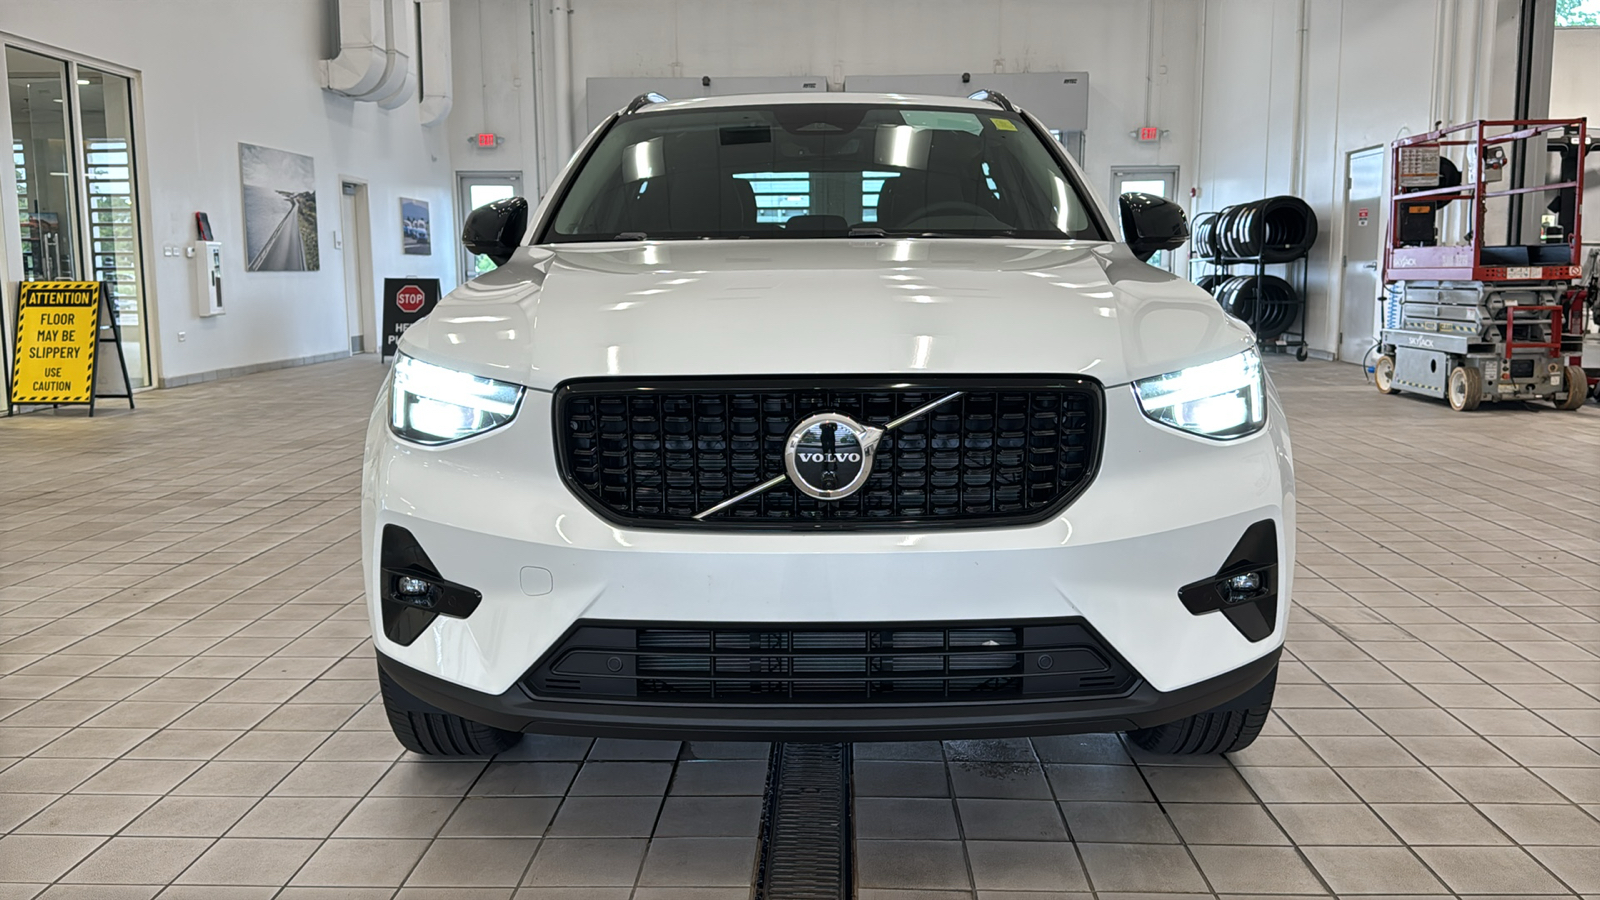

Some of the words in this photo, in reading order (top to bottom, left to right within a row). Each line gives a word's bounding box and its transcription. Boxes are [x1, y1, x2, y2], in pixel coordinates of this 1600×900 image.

[1141, 127, 1157, 140] EXIT
[479, 134, 494, 146] EXIT
[28, 292, 90, 305] ATTENTION
[398, 294, 423, 304] STOP
[40, 313, 75, 325] FLOOR
[37, 330, 59, 342] MAY
[62, 330, 76, 342] BE
[29, 346, 81, 359] SLIPPERY
[44, 367, 62, 378] USE
[32, 381, 71, 392] CAUTION
[798, 453, 860, 463] VOLVO
